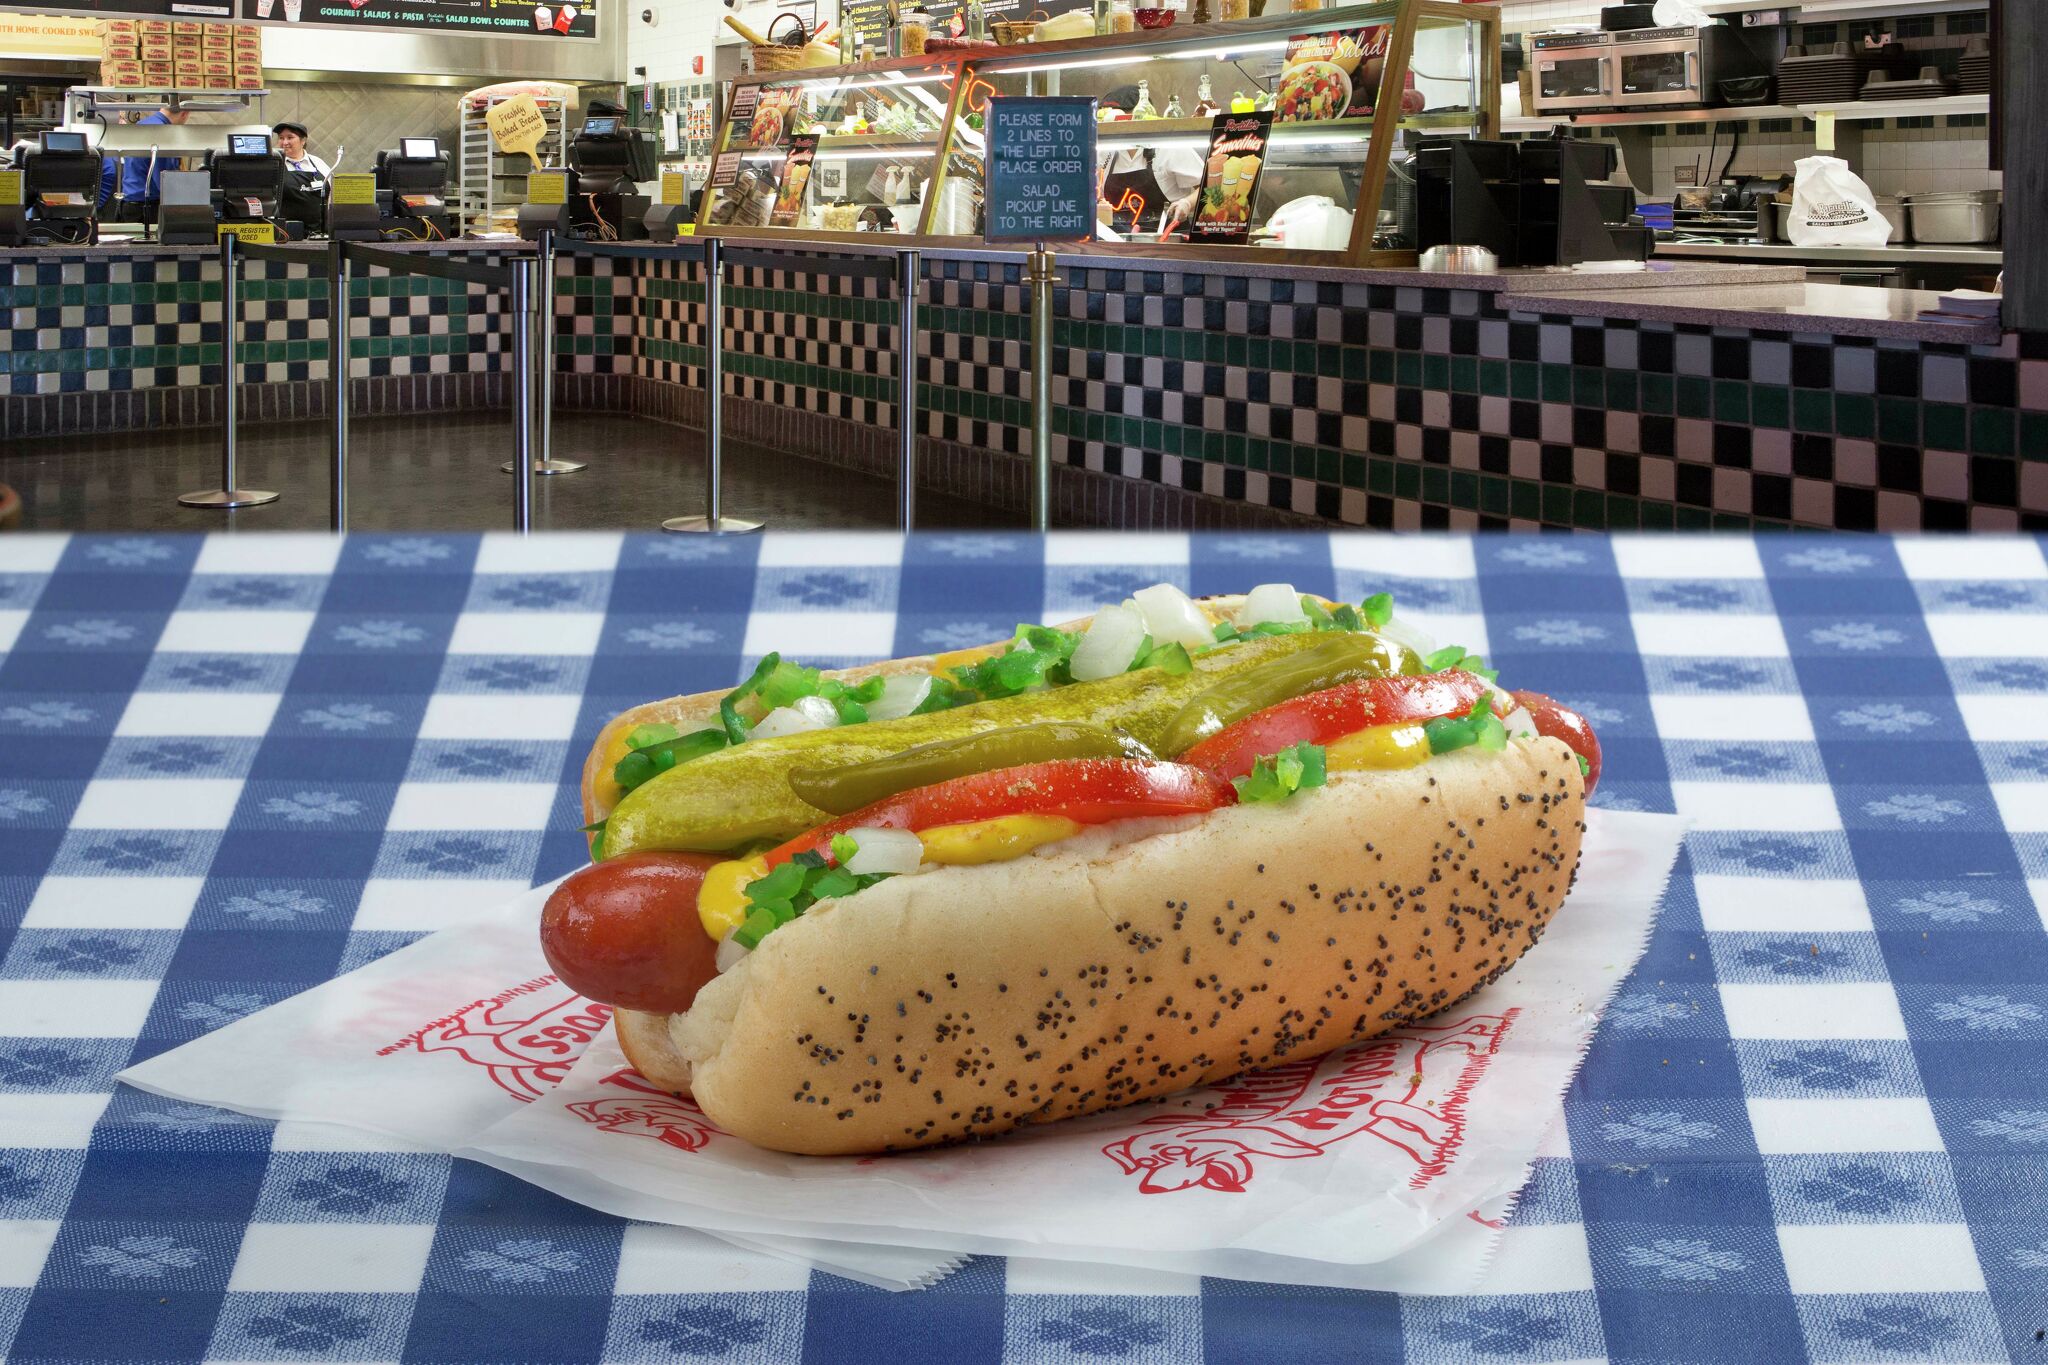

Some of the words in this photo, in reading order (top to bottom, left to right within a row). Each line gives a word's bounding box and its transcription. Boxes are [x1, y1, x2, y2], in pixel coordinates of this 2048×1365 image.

[320, 7, 360, 17] GOURMET
[363, 9, 391, 19] SALADS
[402, 12, 424, 21] PASTA
[446, 14, 468, 24] SALAD
[470, 15, 492, 25] BOWL
[494, 17, 530, 27] COUNTER
[0, 25, 13, 33] ITH
[15, 25, 39, 34] HOME
[42, 26, 76, 36] COOKED
[79, 28, 97, 37] SWE
[1332, 29, 1386, 60] Salad
[499, 105, 526, 123] Freshly
[1000, 114, 1042, 126] PLEASE
[1049, 114, 1082, 126] FORM
[496, 123, 519, 140] Baked
[519, 111, 540, 129] Bread
[1008, 130, 1014, 142] 2
[1020, 130, 1052, 142] LINES
[1058, 130, 1074, 141] TO
[1002, 145, 1024, 157] THE
[1030, 145, 1057, 157] LEFT
[1064, 145, 1080, 156] TO
[1211, 133, 1264, 157] Smoothies
[1000, 161, 1037, 173] PLACE
[1043, 161, 1082, 173] ORDER
[1022, 184, 1060, 197] SALAD
[1006, 200, 1047, 212] PICKUP
[1052, 200, 1076, 212] LINE
[1000, 216, 1015, 228] TO
[1022, 216, 1044, 228] THE
[1050, 215, 1083, 228] RIGHT
[1322, 1043, 1402, 1086] DOGS
[1273, 1084, 1383, 1131] HOT
